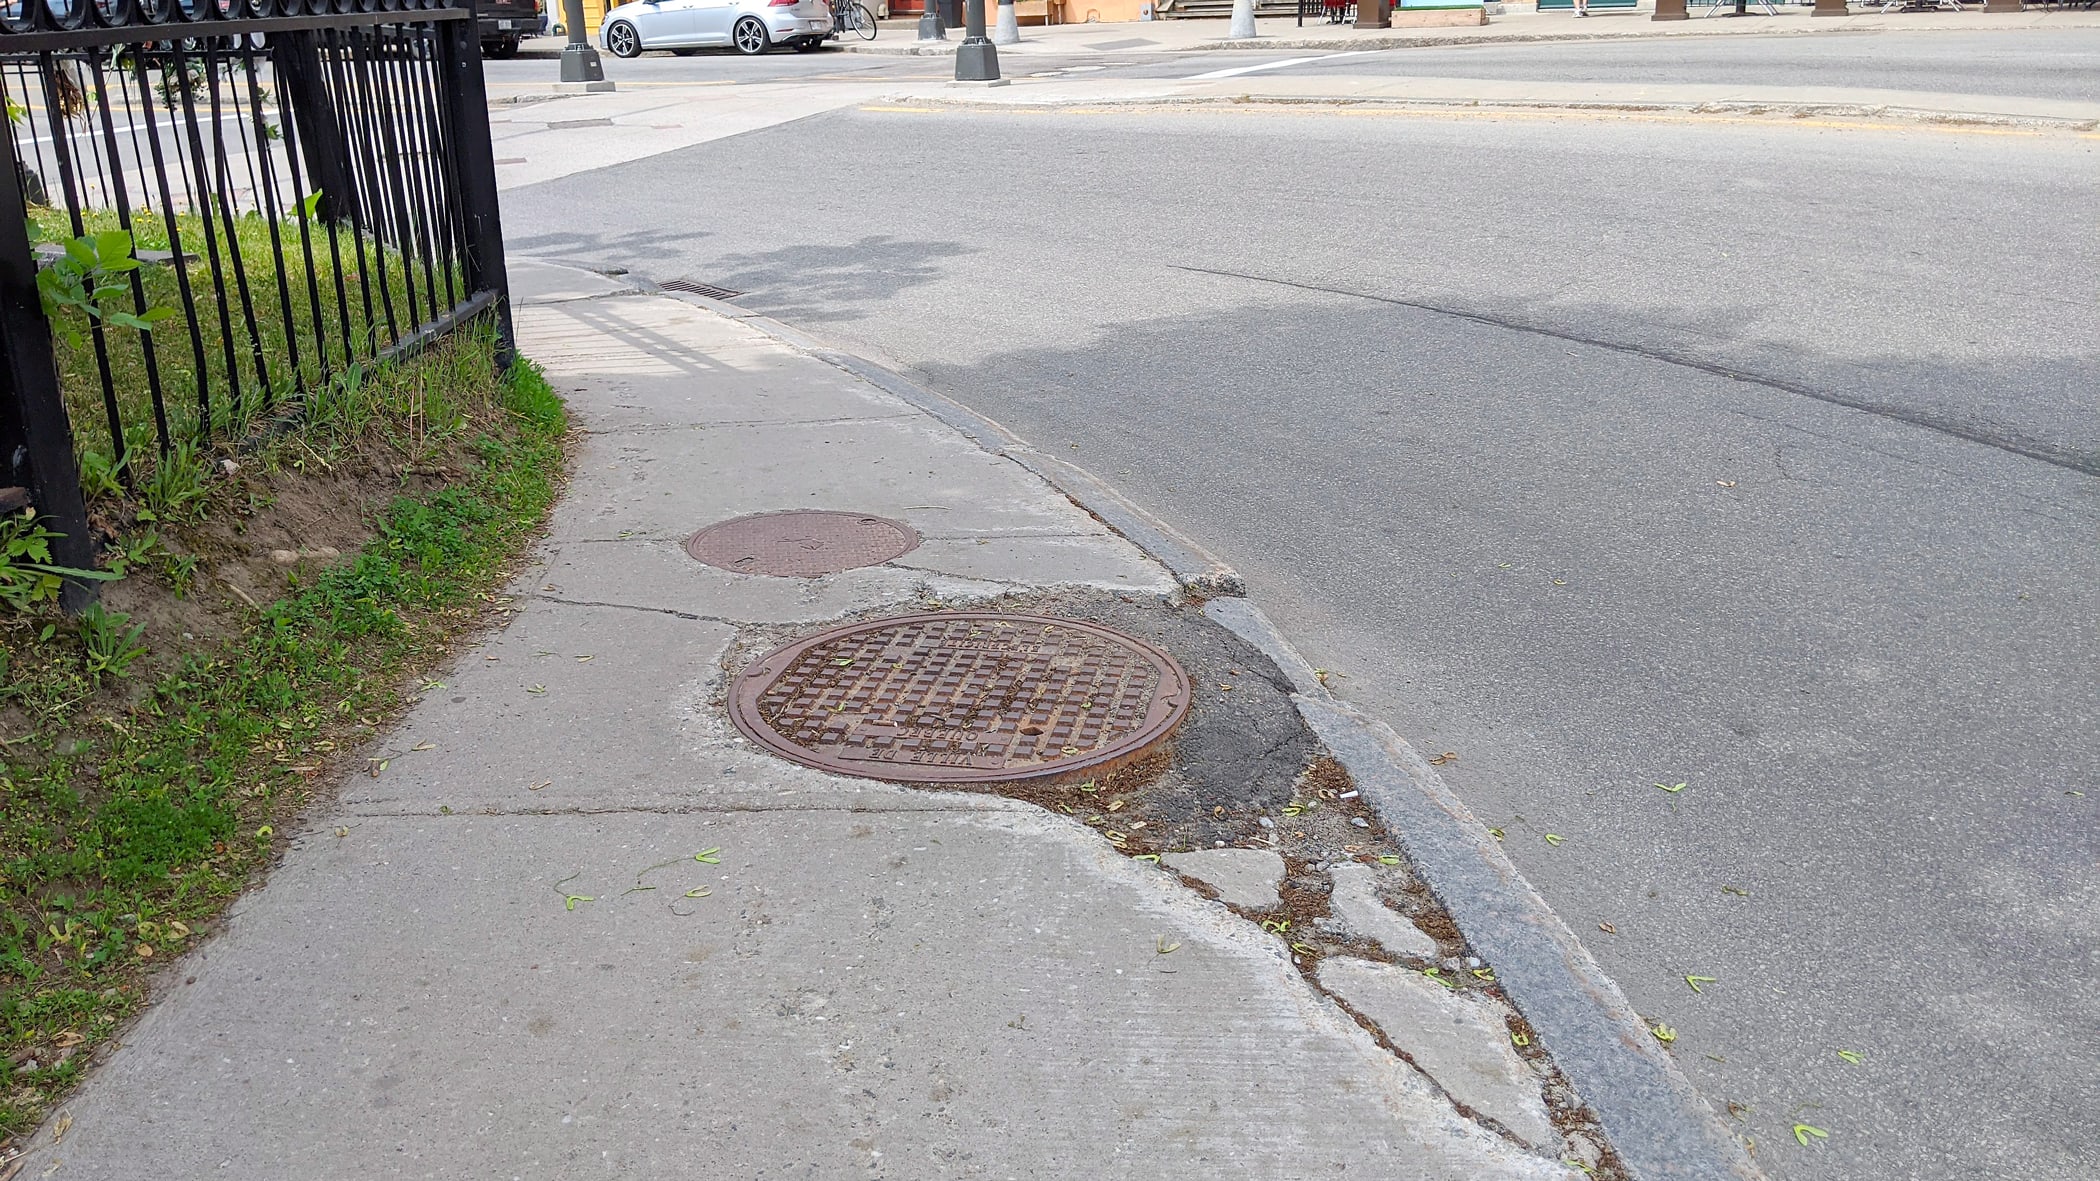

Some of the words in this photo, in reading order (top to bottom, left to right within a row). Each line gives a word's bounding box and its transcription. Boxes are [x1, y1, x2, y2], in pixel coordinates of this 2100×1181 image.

[896, 726, 979, 742] QUEBEC
[868, 749, 898, 760] DE
[910, 750, 972, 765] VILLE
